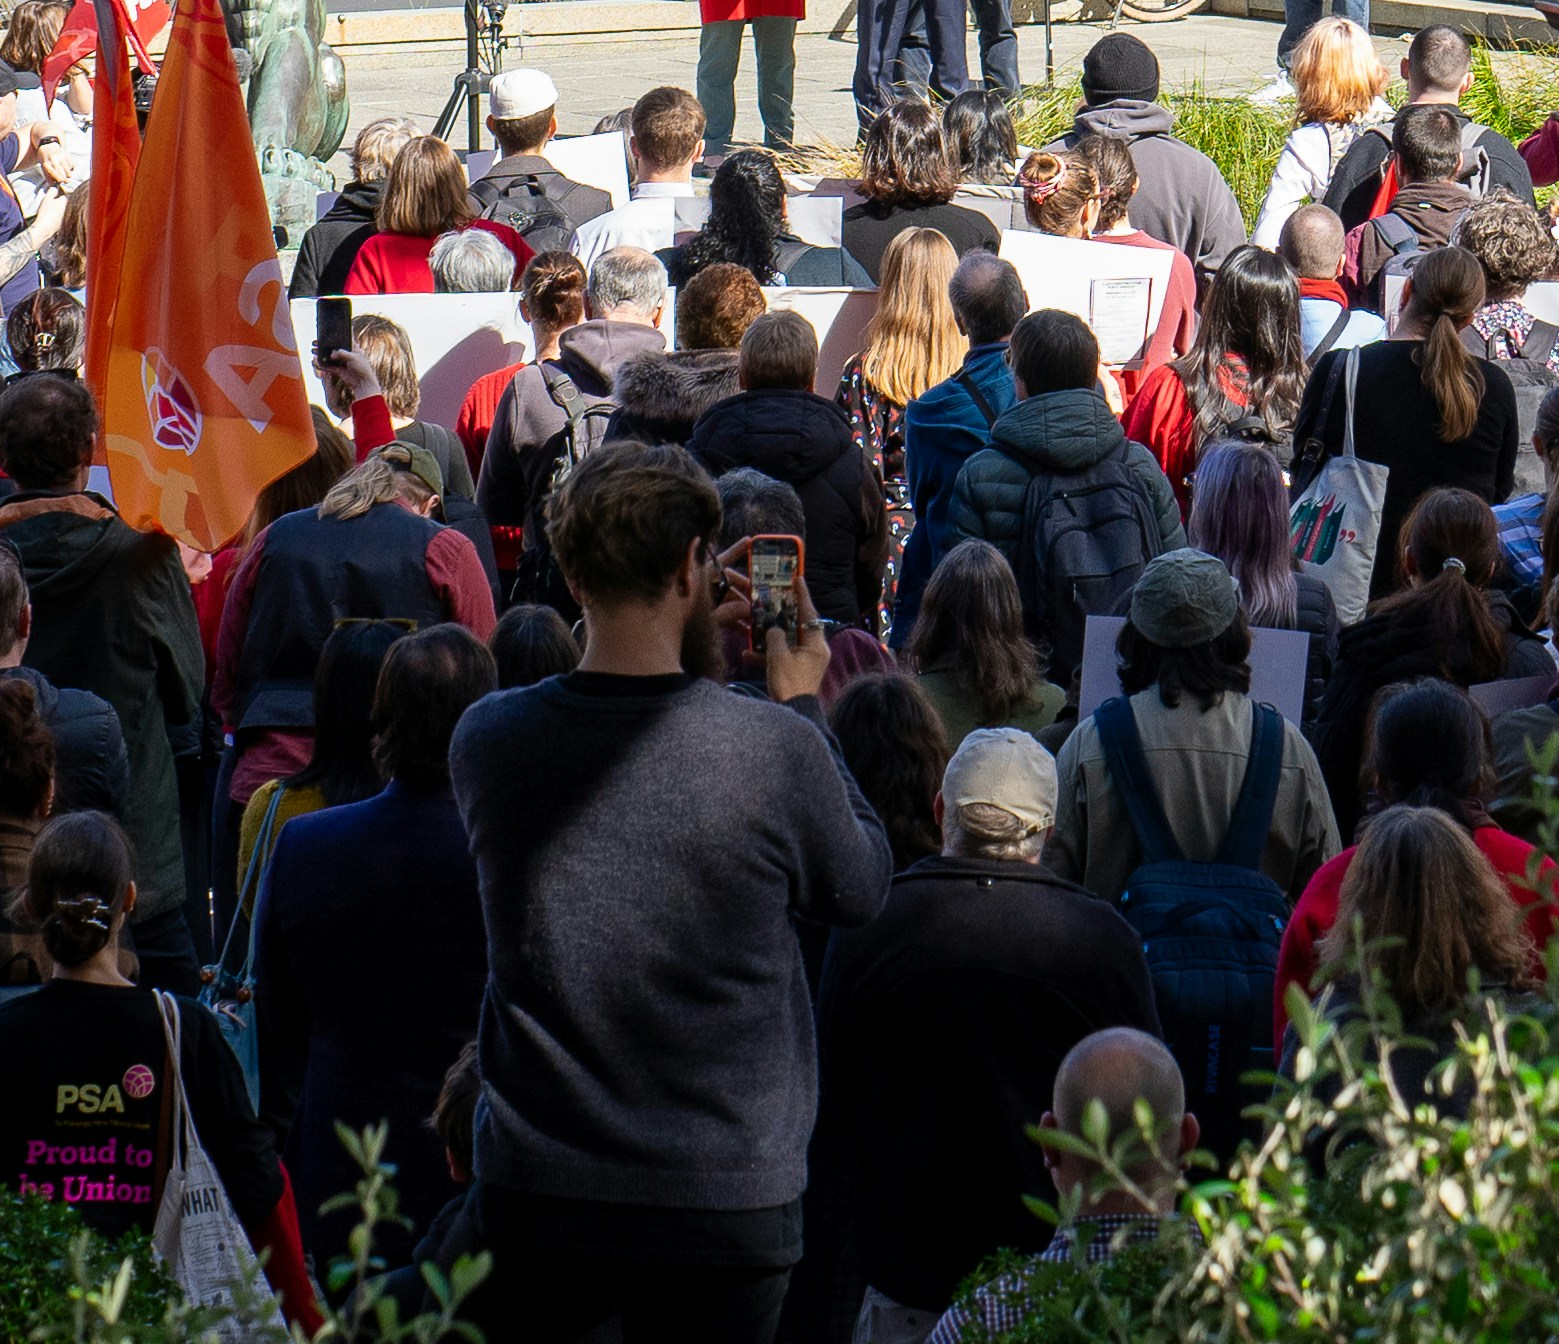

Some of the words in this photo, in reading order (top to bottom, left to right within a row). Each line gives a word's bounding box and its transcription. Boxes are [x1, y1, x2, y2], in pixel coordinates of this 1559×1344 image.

[56, 1084, 125, 1114] PSA
[24, 1137, 118, 1165] Proud
[124, 1143, 153, 1168] to
[62, 1173, 152, 1204] Union
